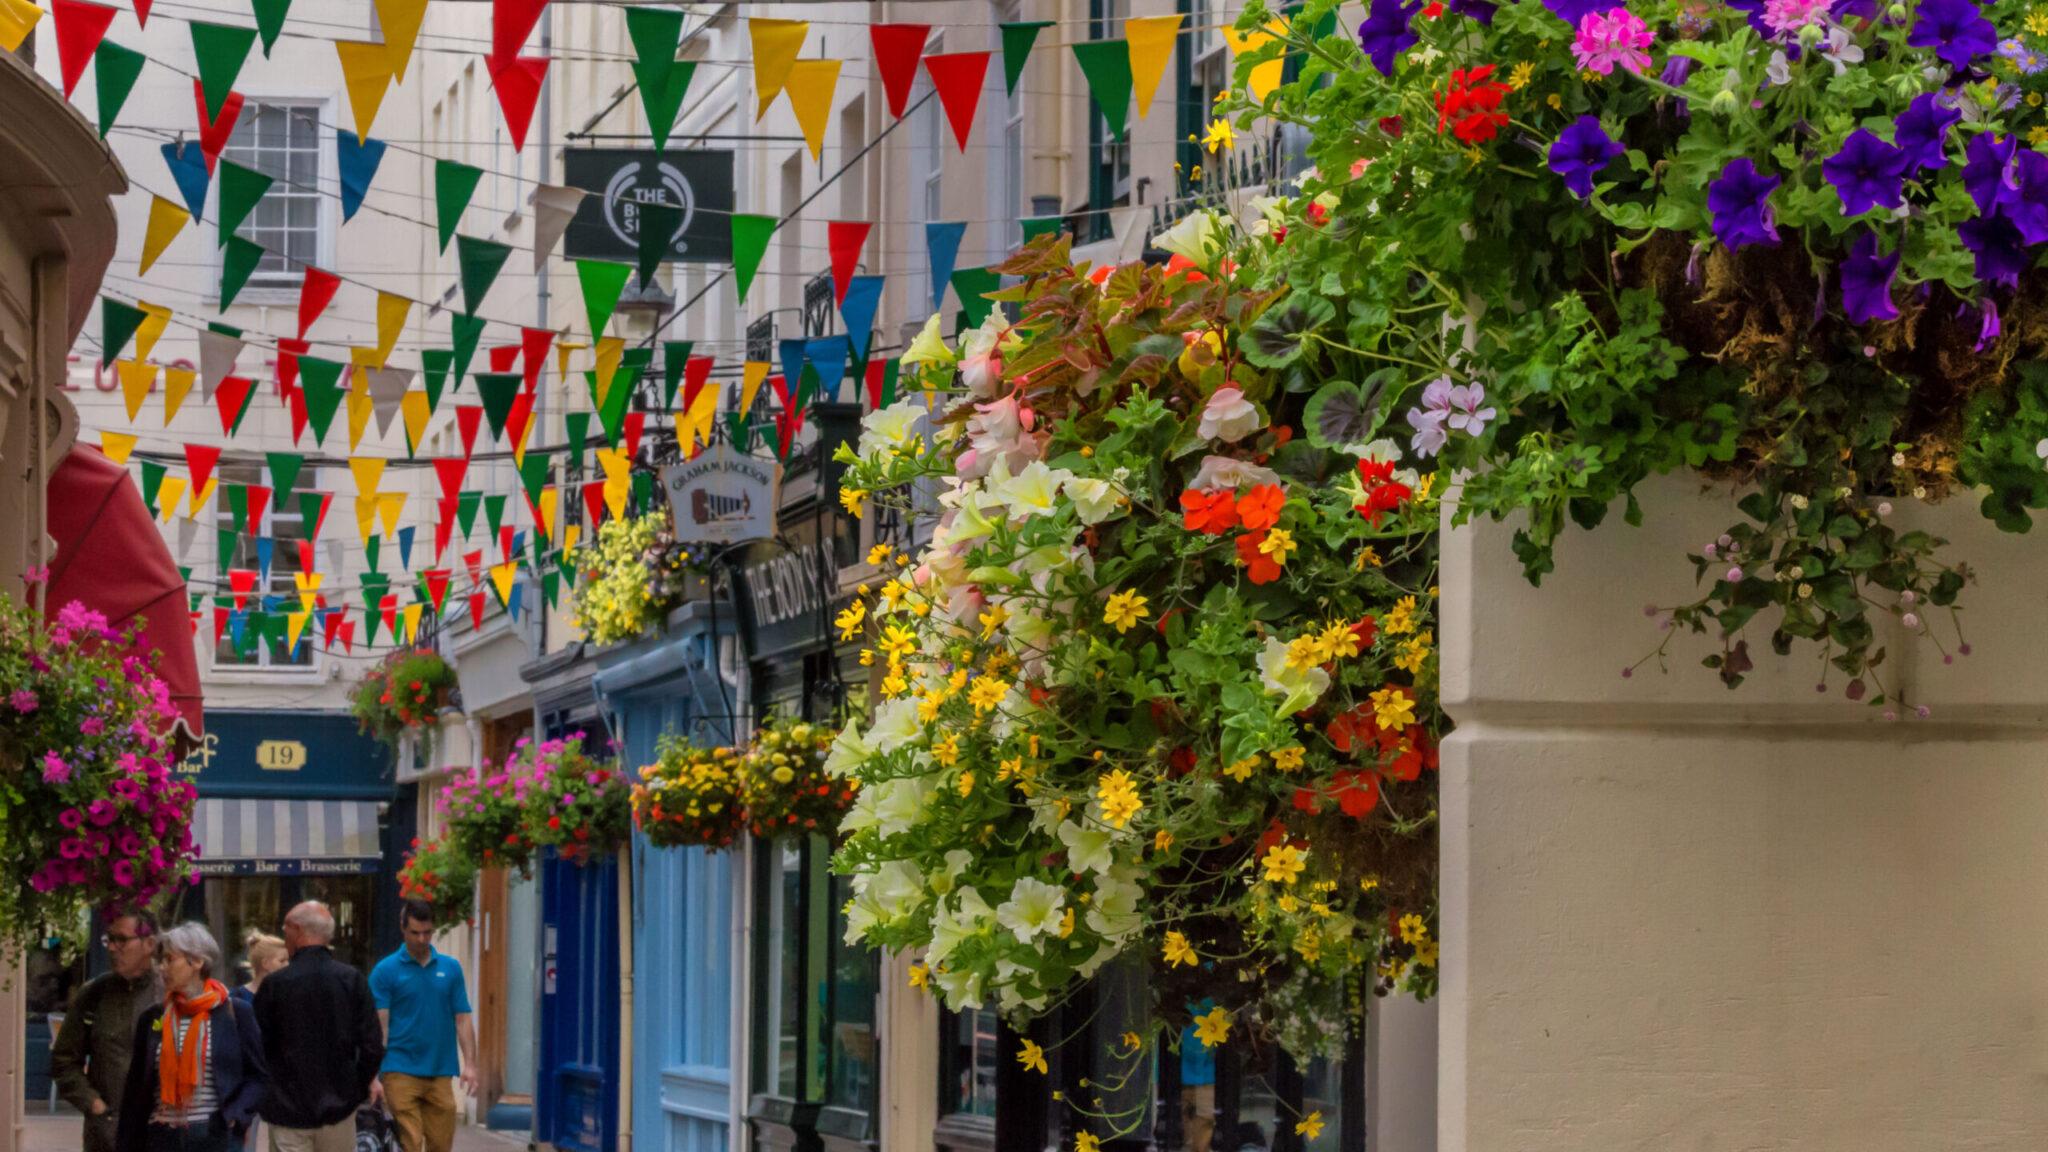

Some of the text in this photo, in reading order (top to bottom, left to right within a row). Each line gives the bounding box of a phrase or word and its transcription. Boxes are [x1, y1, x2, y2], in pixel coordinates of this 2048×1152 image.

[634, 188, 666, 203] THE
[672, 461, 769, 490] GRAHAM JACKSON
[270, 744, 294, 765] 19
[177, 760, 203, 773] Bar
[255, 859, 280, 872] Bar
[300, 859, 361, 872] Brasserie
